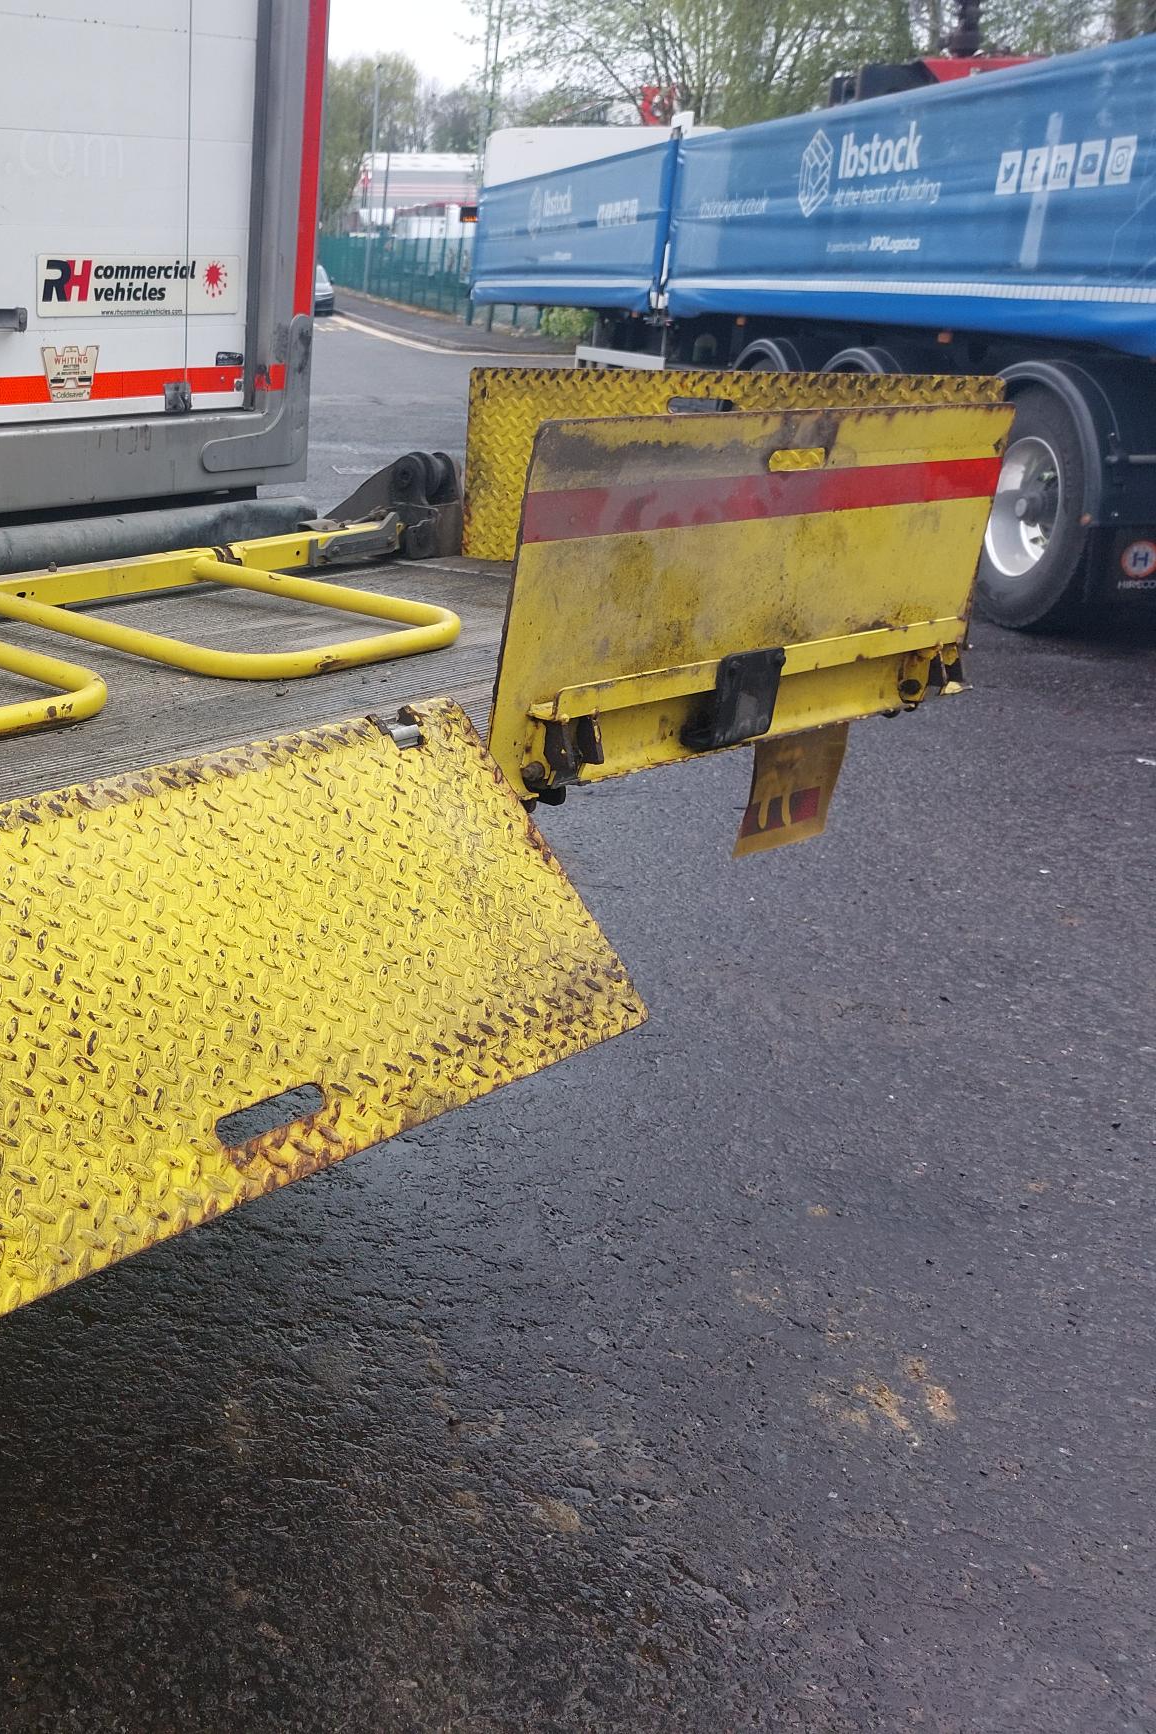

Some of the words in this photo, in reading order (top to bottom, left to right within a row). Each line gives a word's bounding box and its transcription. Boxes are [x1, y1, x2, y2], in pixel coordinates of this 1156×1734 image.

[838, 120, 922, 179] Ibstock
[860, 184, 887, 204] heart
[887, 179, 901, 203] of
[900, 177, 942, 205] building
[42, 259, 93, 302] RH
[94, 260, 197, 280] commercial
[94, 282, 166, 302] vehicles
[54, 356, 88, 365] WHITING
